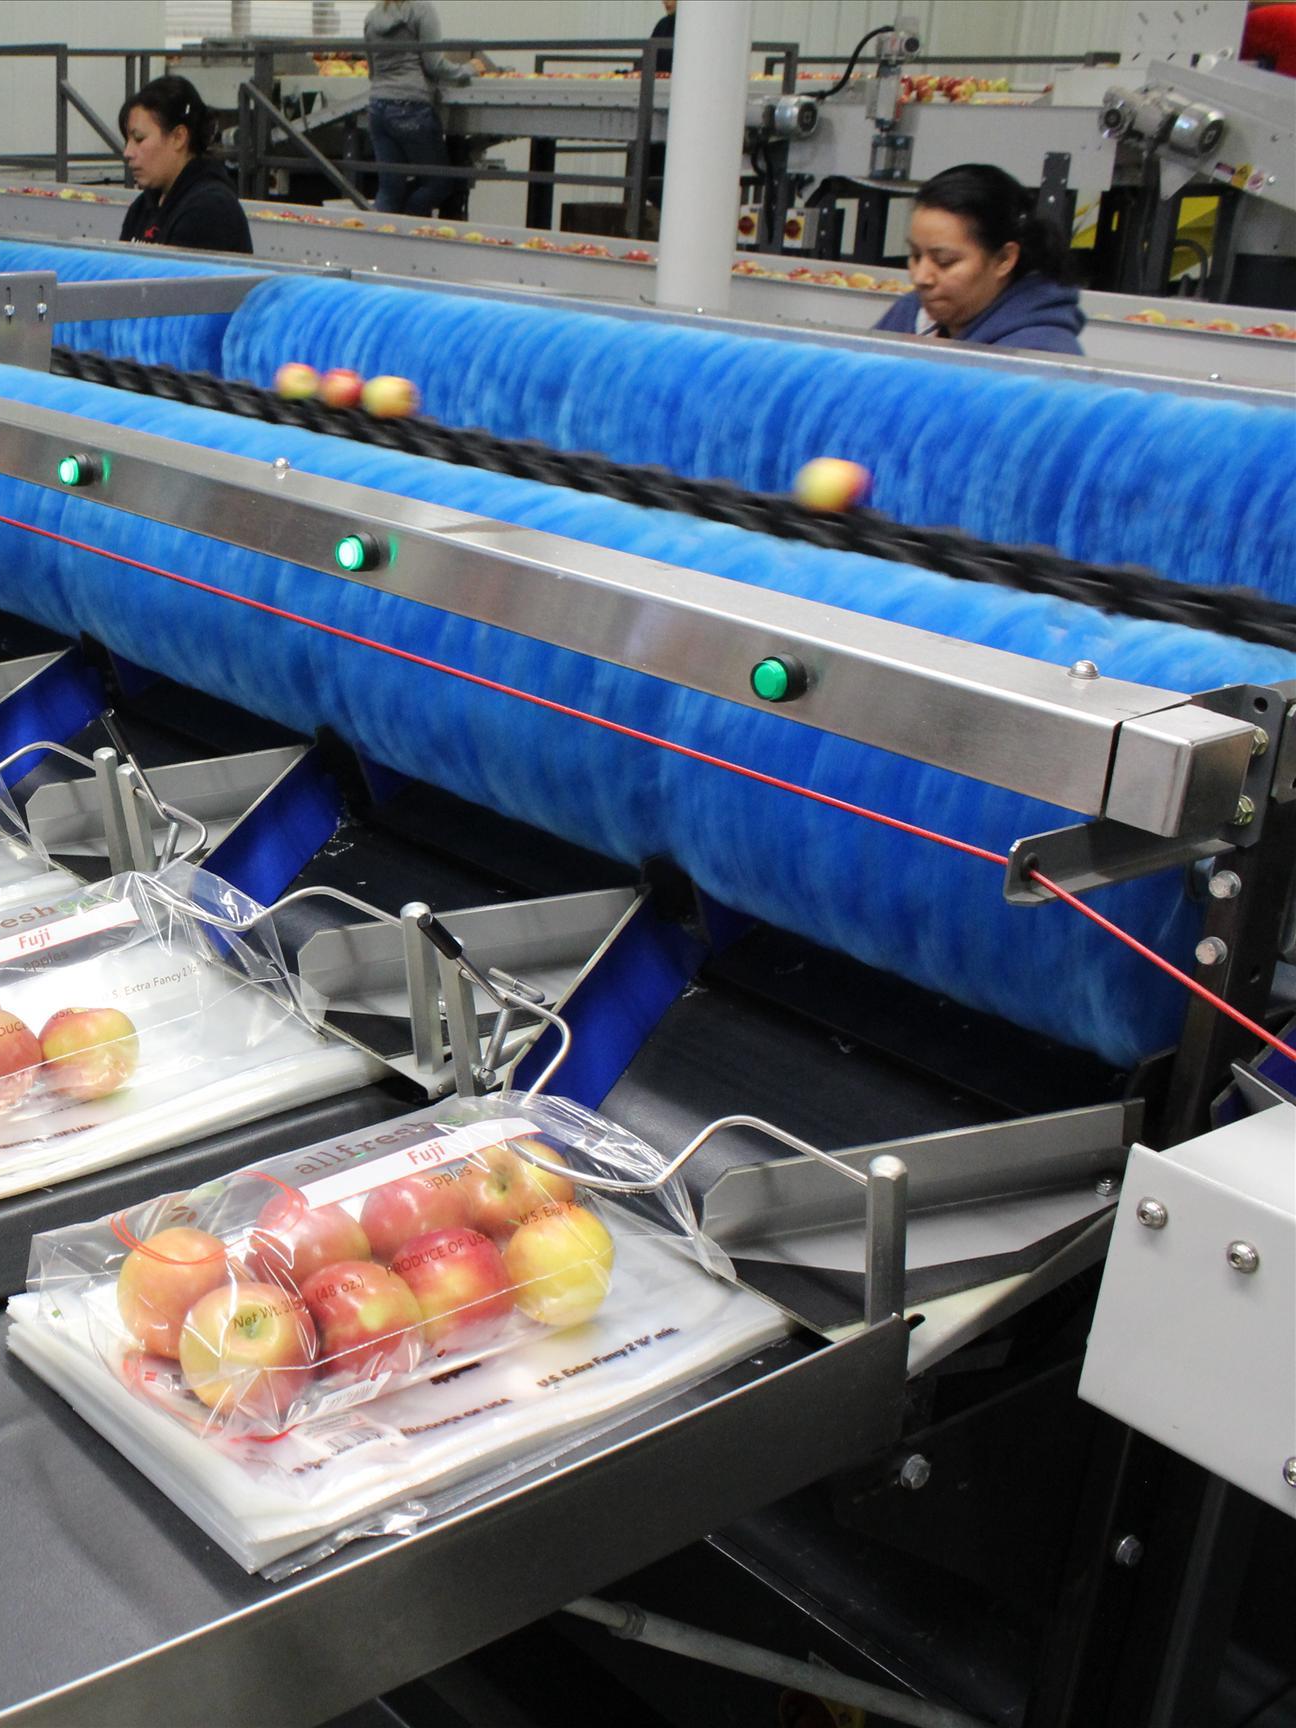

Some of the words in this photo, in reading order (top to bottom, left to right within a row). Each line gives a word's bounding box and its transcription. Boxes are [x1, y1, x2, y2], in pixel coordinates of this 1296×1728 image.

[18, 927, 52, 950] Fuji
[23, 949, 70, 972] apples
[124, 981, 151, 996] Extra
[152, 972, 182, 987] Fancy
[295, 1119, 435, 1176] allfresh
[407, 1142, 447, 1166] Fuji
[423, 1164, 474, 1190] apples
[519, 1210, 543, 1227] U.S.
[385, 1249, 446, 1278] PRODUCE
[447, 1238, 465, 1254] OF
[233, 1313, 258, 1330] Net
[259, 1304, 281, 1320] Wt.
[314, 1284, 338, 1303] (48
[340, 1273, 365, 1293] oz.)
[536, 1373, 566, 1388] U.S.
[561, 1361, 593, 1378] Extra
[591, 1347, 629, 1366] Fancy
